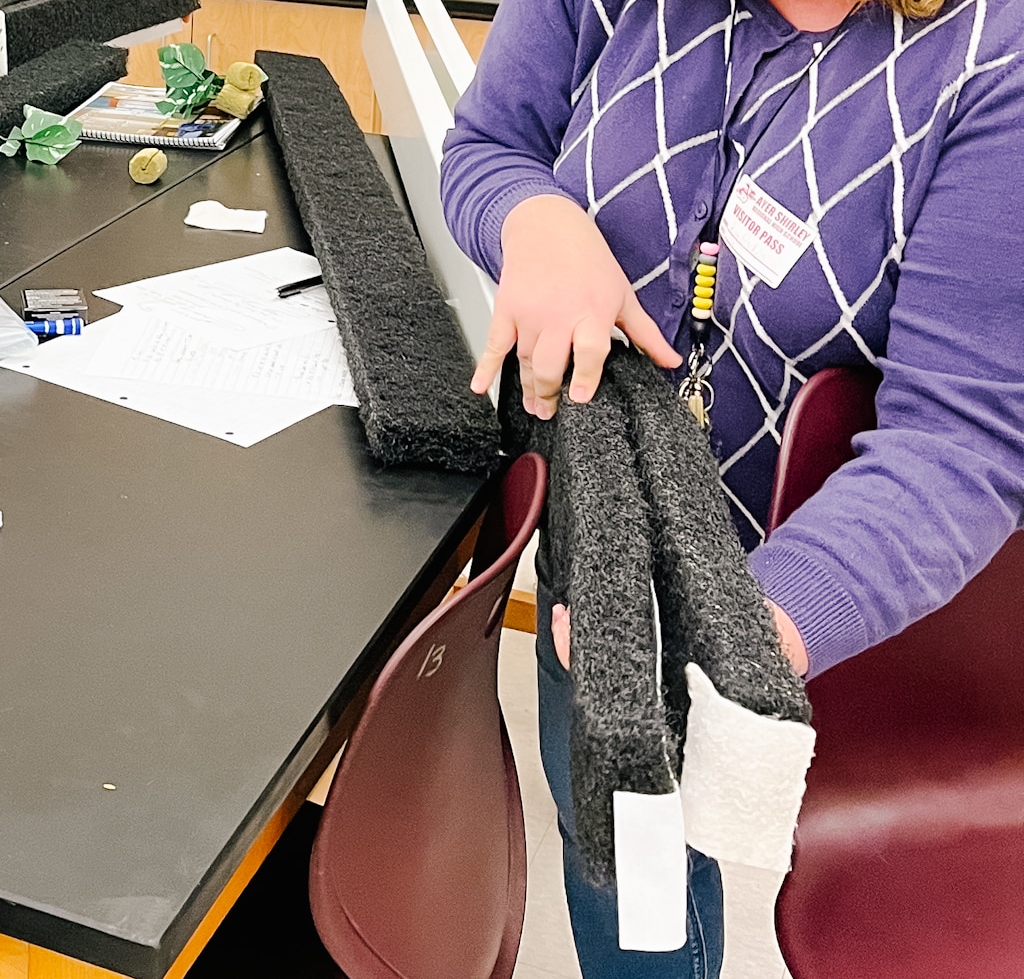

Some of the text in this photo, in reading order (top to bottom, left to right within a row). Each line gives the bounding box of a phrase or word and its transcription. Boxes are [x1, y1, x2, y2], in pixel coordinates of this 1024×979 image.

[733, 203, 762, 238] VISITOR
[759, 230, 785, 255] PASS
[756, 196, 811, 242] AYER SHIRLEY
[417, 643, 446, 680] 13
